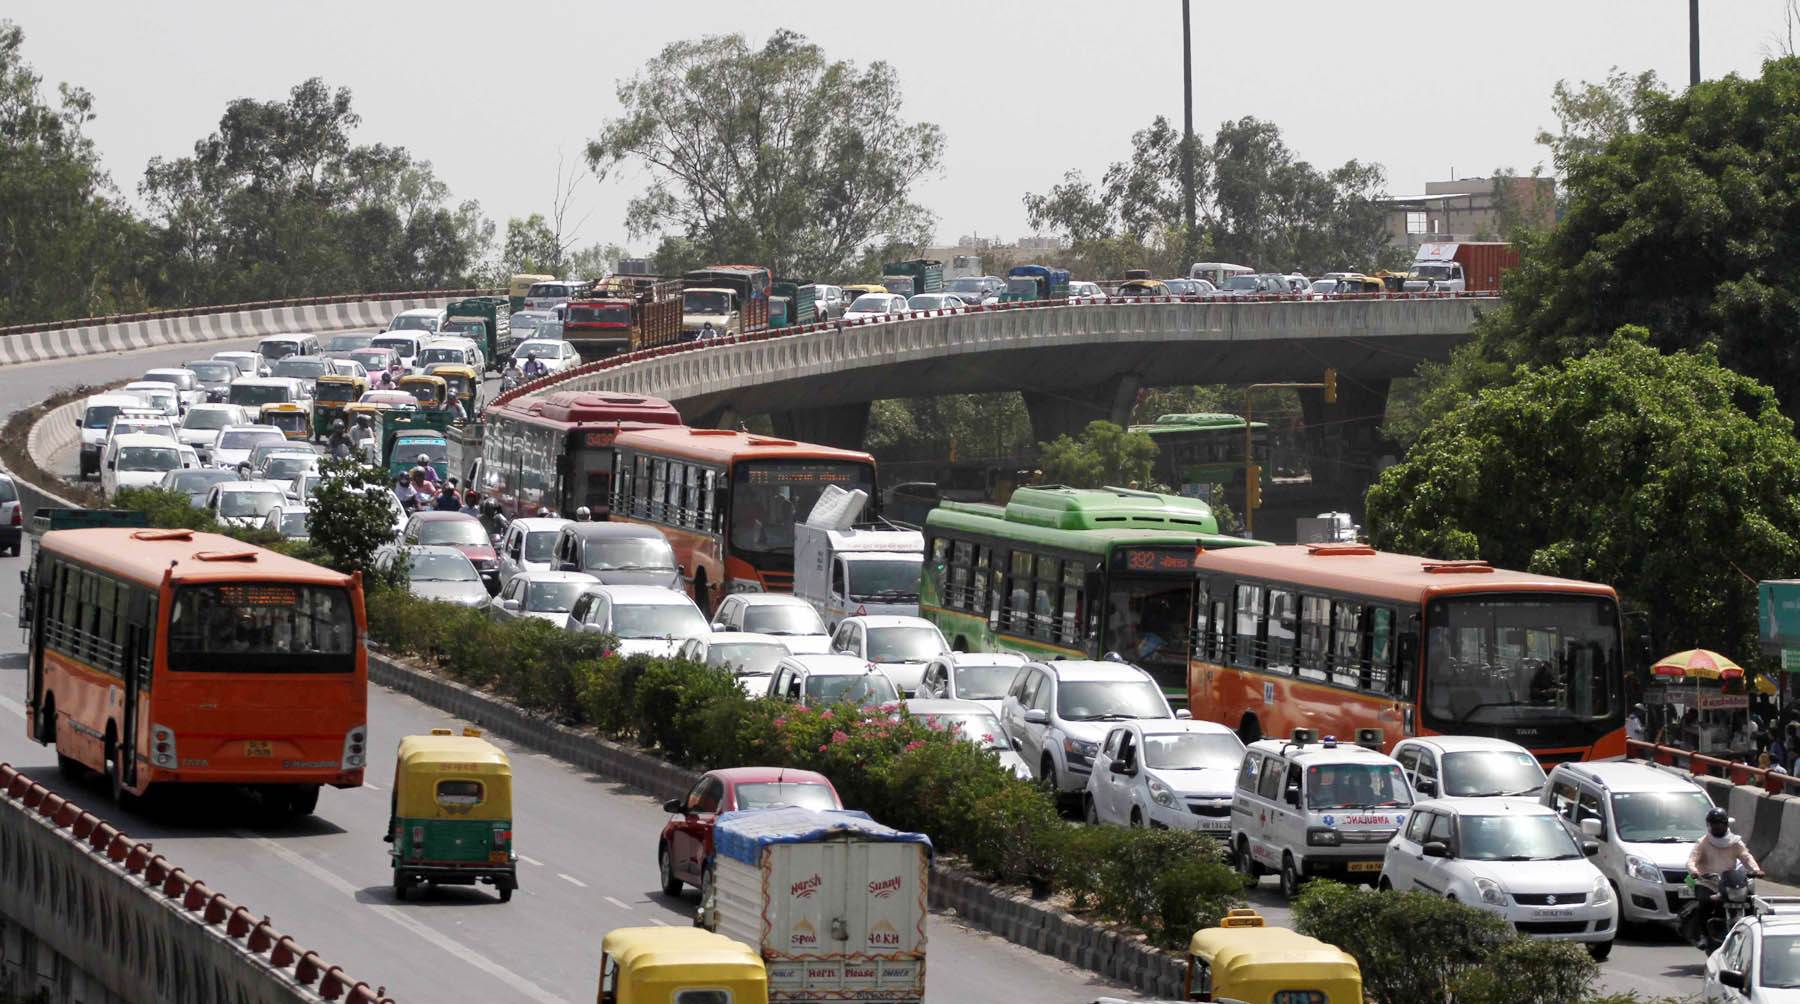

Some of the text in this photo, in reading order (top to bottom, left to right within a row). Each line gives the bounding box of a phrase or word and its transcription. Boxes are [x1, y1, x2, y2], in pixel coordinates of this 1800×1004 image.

[1128, 551, 1156, 569] 392
[868, 876, 902, 893] Sunny
[845, 968, 874, 977] Please
